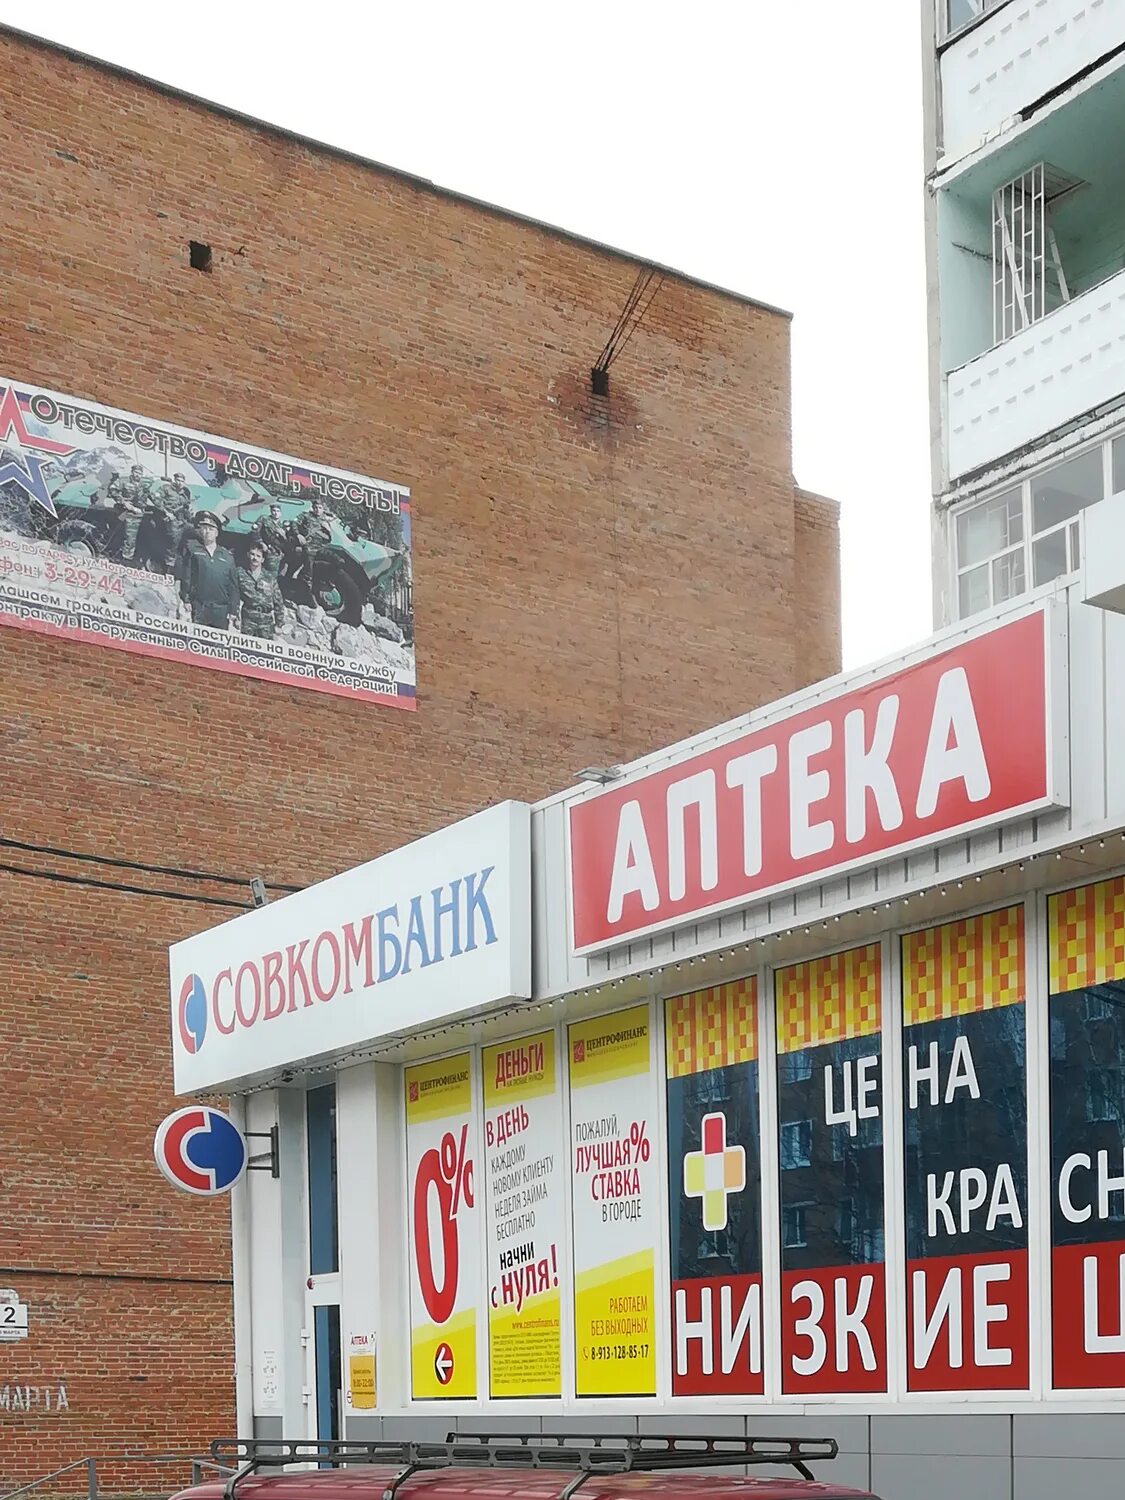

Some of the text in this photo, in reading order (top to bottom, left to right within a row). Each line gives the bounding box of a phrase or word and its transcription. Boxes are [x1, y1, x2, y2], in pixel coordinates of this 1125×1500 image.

[29, 394, 401, 514] Отечество, долг, честь!
[44, 561, 124, 597] 3-29-44
[66, 600, 131, 622] граждан
[136, 611, 189, 634] России
[193, 625, 262, 650] поступить
[266, 643, 284, 655] на
[288, 648, 346, 669] военную
[349, 660, 397, 681] службу
[68, 616, 77, 627] в
[83, 619, 186, 650] Вооруженные
[190, 641, 228, 660] Силы
[233, 650, 315, 677] Российской
[318, 669, 398, 695] Федерации!
[606, 666, 993, 924] АПТЕКА
[212, 865, 499, 1035] СОВКОМБАНК
[587, 1025, 648, 1052] ЦЕНТРОФИНАНС
[495, 1042, 544, 1089] ДЕНЬГИ
[824, 1035, 981, 1137] ЦЕНА
[486, 1104, 529, 1148] В ДЕНЬ
[576, 1113, 620, 1142] ПОЖАЛУЙ,
[490, 1143, 526, 1175] КАЖДОМУ
[493, 1154, 554, 1197] НОВОМУ КЛИЕНТУ
[495, 1182, 548, 1219] НЕДЕЛЯ ЗАЙМА
[591, 1167, 641, 1201] СТАВКА
[496, 1210, 536, 1242] БЕСПЛАТНО
[602, 1199, 642, 1223] В ГОРОДЕ
[499, 1241, 535, 1271] начни
[4, 1306, 16, 1323] 2
[609, 1295, 648, 1314] РАБОТАЕМ
[675, 1262, 1013, 1377] НИЗКИЕ
[591, 1317, 649, 1337] БЕЗ ВЫХОДНЫХ
